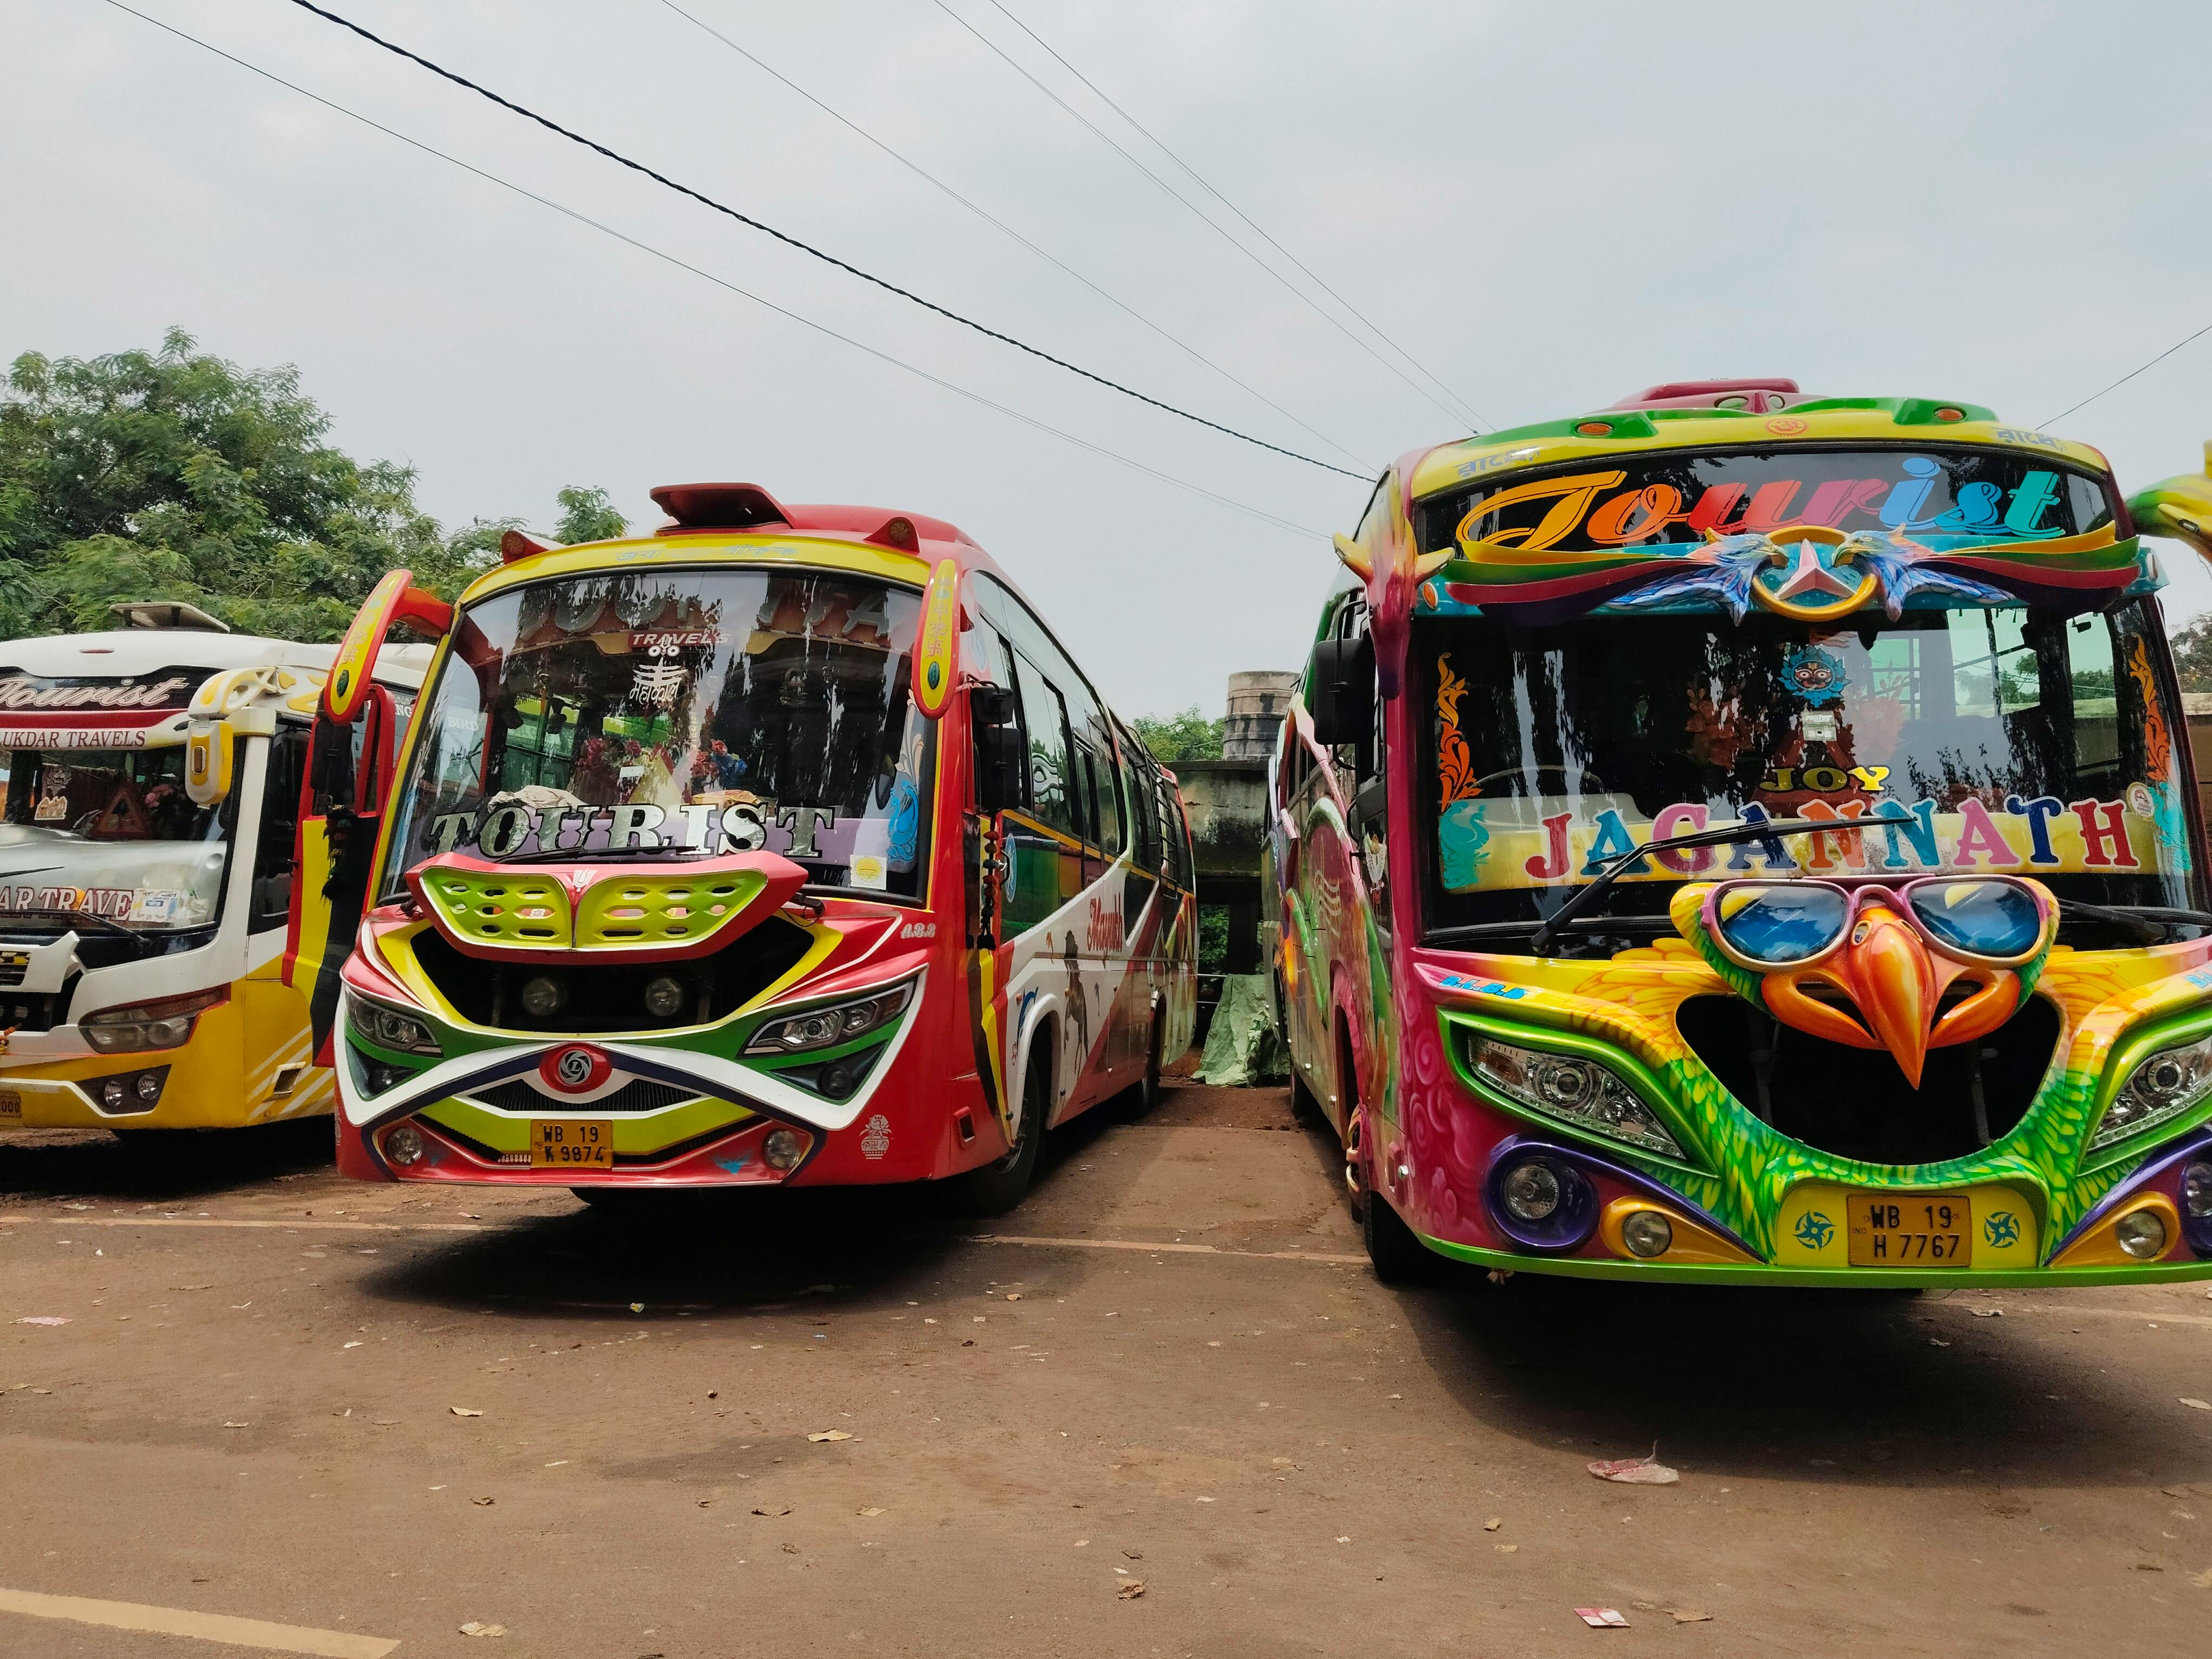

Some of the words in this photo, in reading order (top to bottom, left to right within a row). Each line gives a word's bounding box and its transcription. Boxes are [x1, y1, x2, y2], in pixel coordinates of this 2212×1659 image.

[1456, 457, 2066, 551] Tourist
[0, 677, 189, 707] Tourist
[447, 716, 479, 731] BIRD
[0, 731, 59, 748] UKDAR
[66, 730, 145, 747] TRAVELS
[1759, 766, 1891, 792] JOY
[429, 803, 835, 859] TOURIST
[1525, 794, 2140, 880] JAGANNATH
[544, 1125, 563, 1142] WB
[580, 1125, 599, 1142] 19
[544, 1145, 554, 1162] K
[561, 1145, 605, 1162] 9874
[1871, 1205, 1900, 1229] WB
[1925, 1205, 1952, 1229] 19
[1874, 1233, 1887, 1258] H
[1899, 1233, 1960, 1258] 7767
